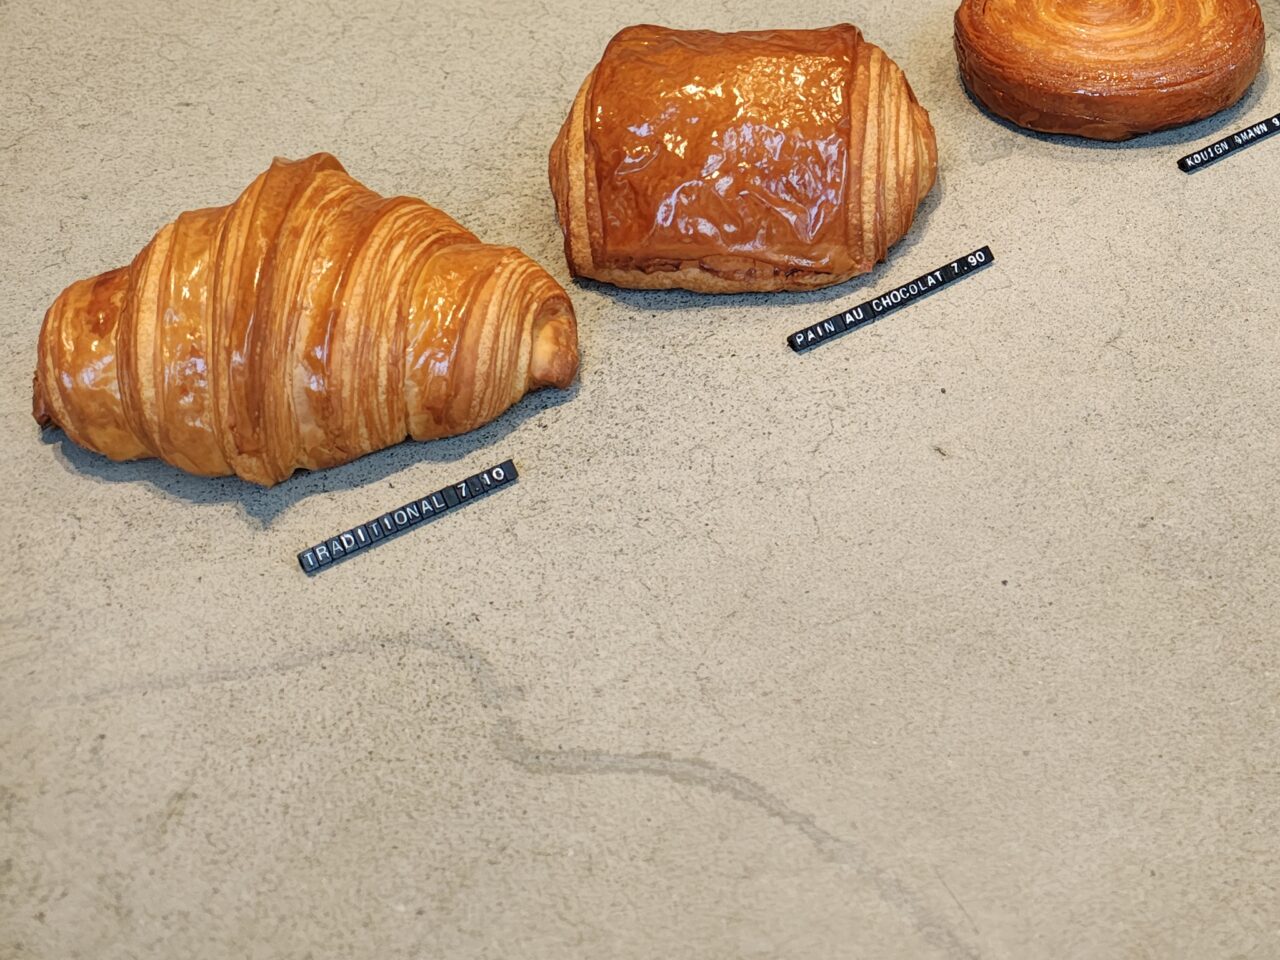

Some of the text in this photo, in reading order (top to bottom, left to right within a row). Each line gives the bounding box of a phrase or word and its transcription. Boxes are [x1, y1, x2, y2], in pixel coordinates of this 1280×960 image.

[1185, 141, 1229, 167] KOUIGN
[795, 251, 986, 345] PAIN AU CHOCOLAT 7.90
[303, 466, 506, 567] TRADITIONAL 7.10
